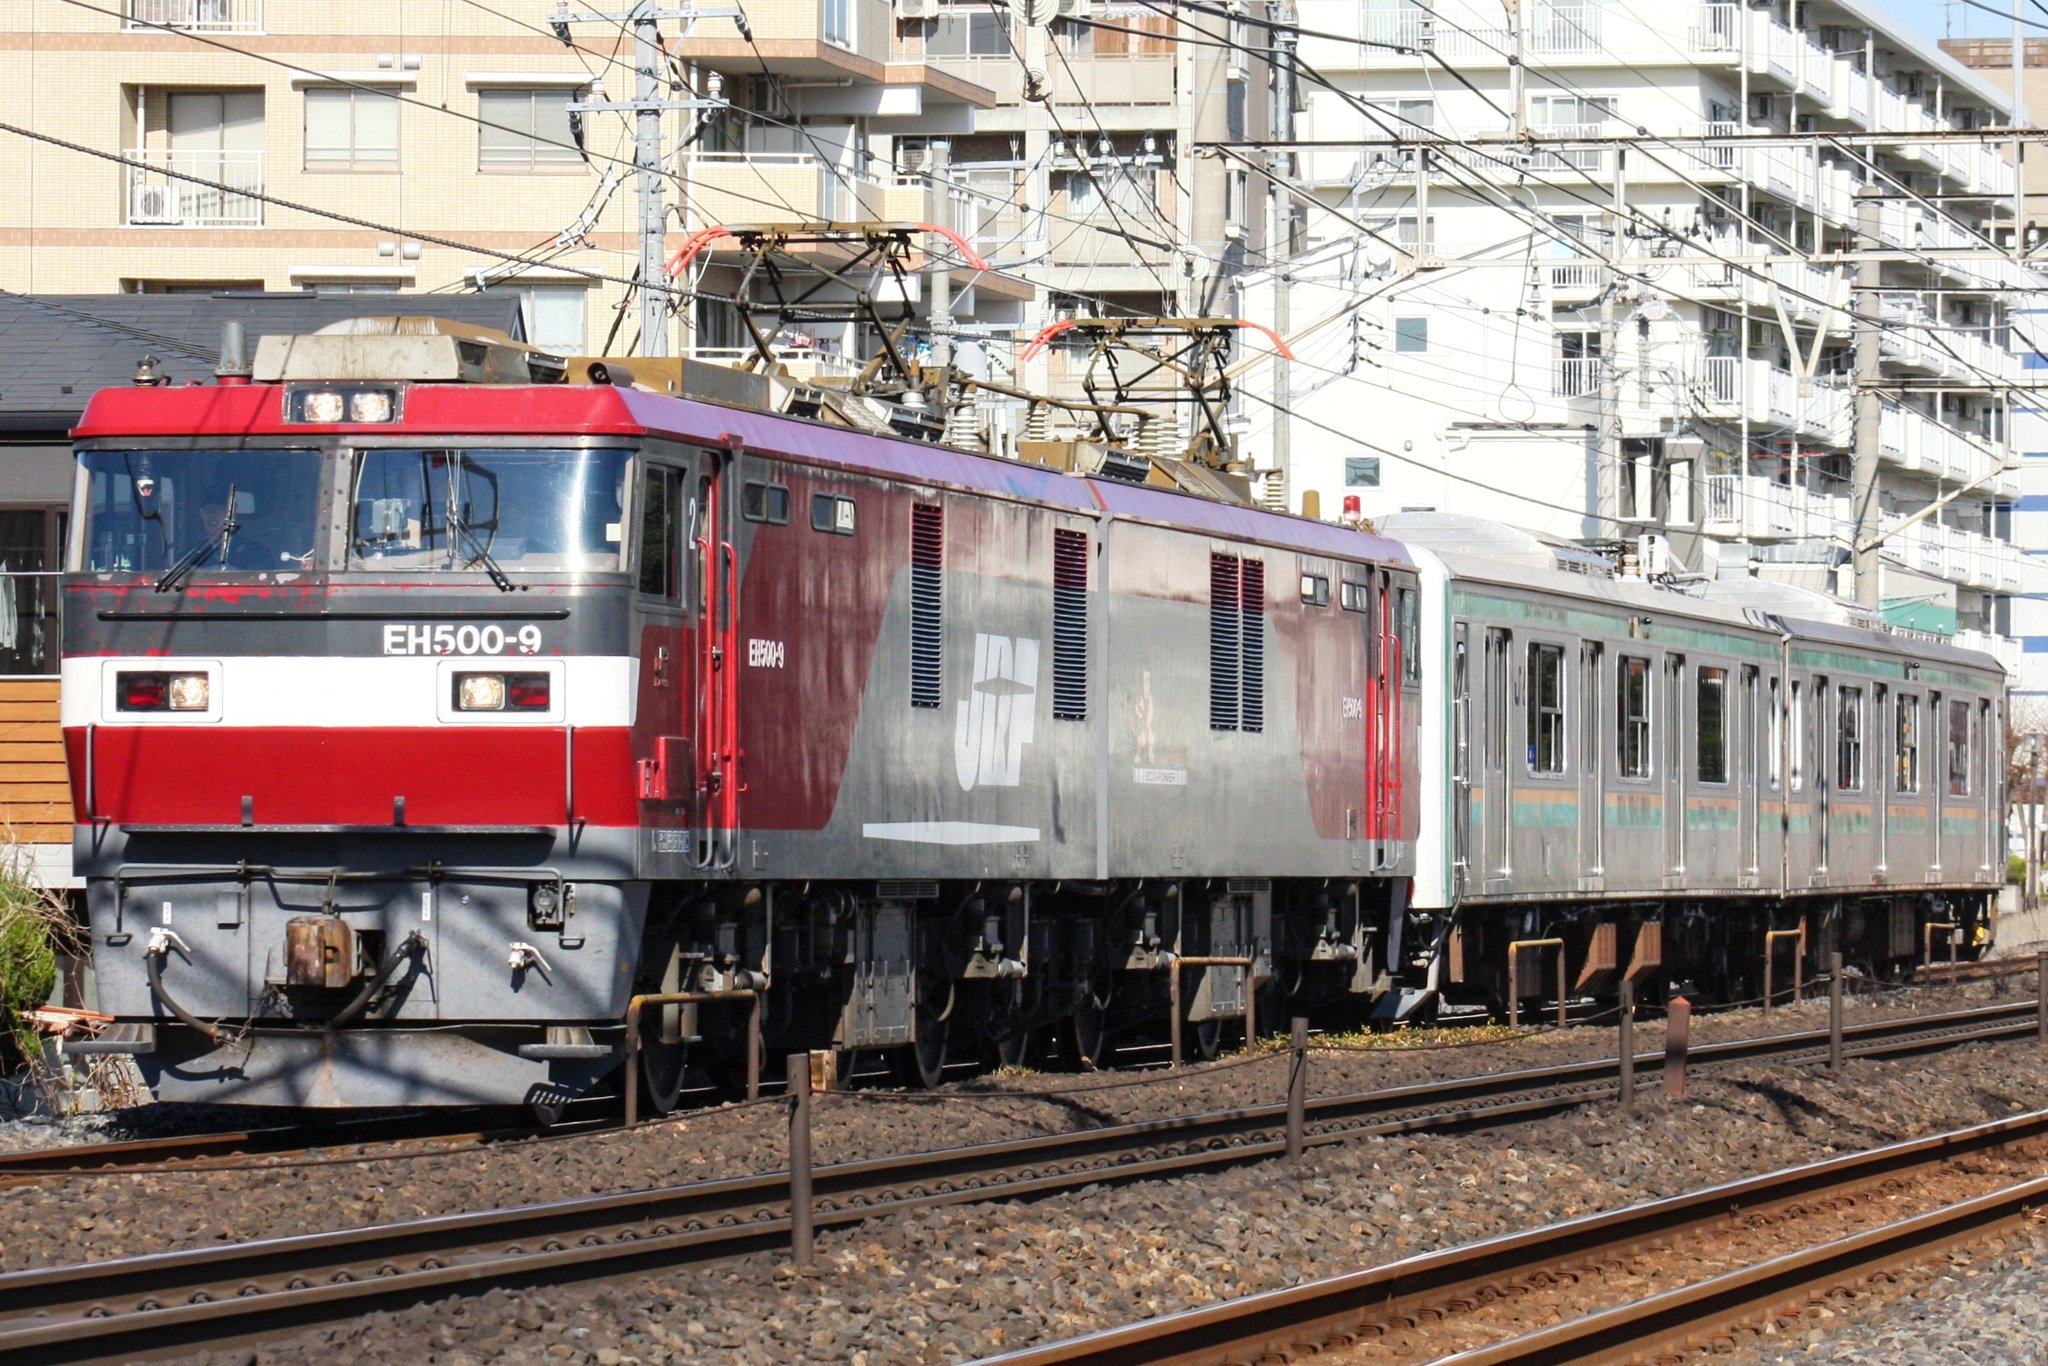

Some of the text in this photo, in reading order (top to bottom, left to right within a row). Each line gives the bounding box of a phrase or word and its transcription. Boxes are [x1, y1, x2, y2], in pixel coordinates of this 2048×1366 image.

[688, 497, 697, 550] 2
[383, 624, 542, 655] EH500-9
[748, 638, 785, 669] EH500-9
